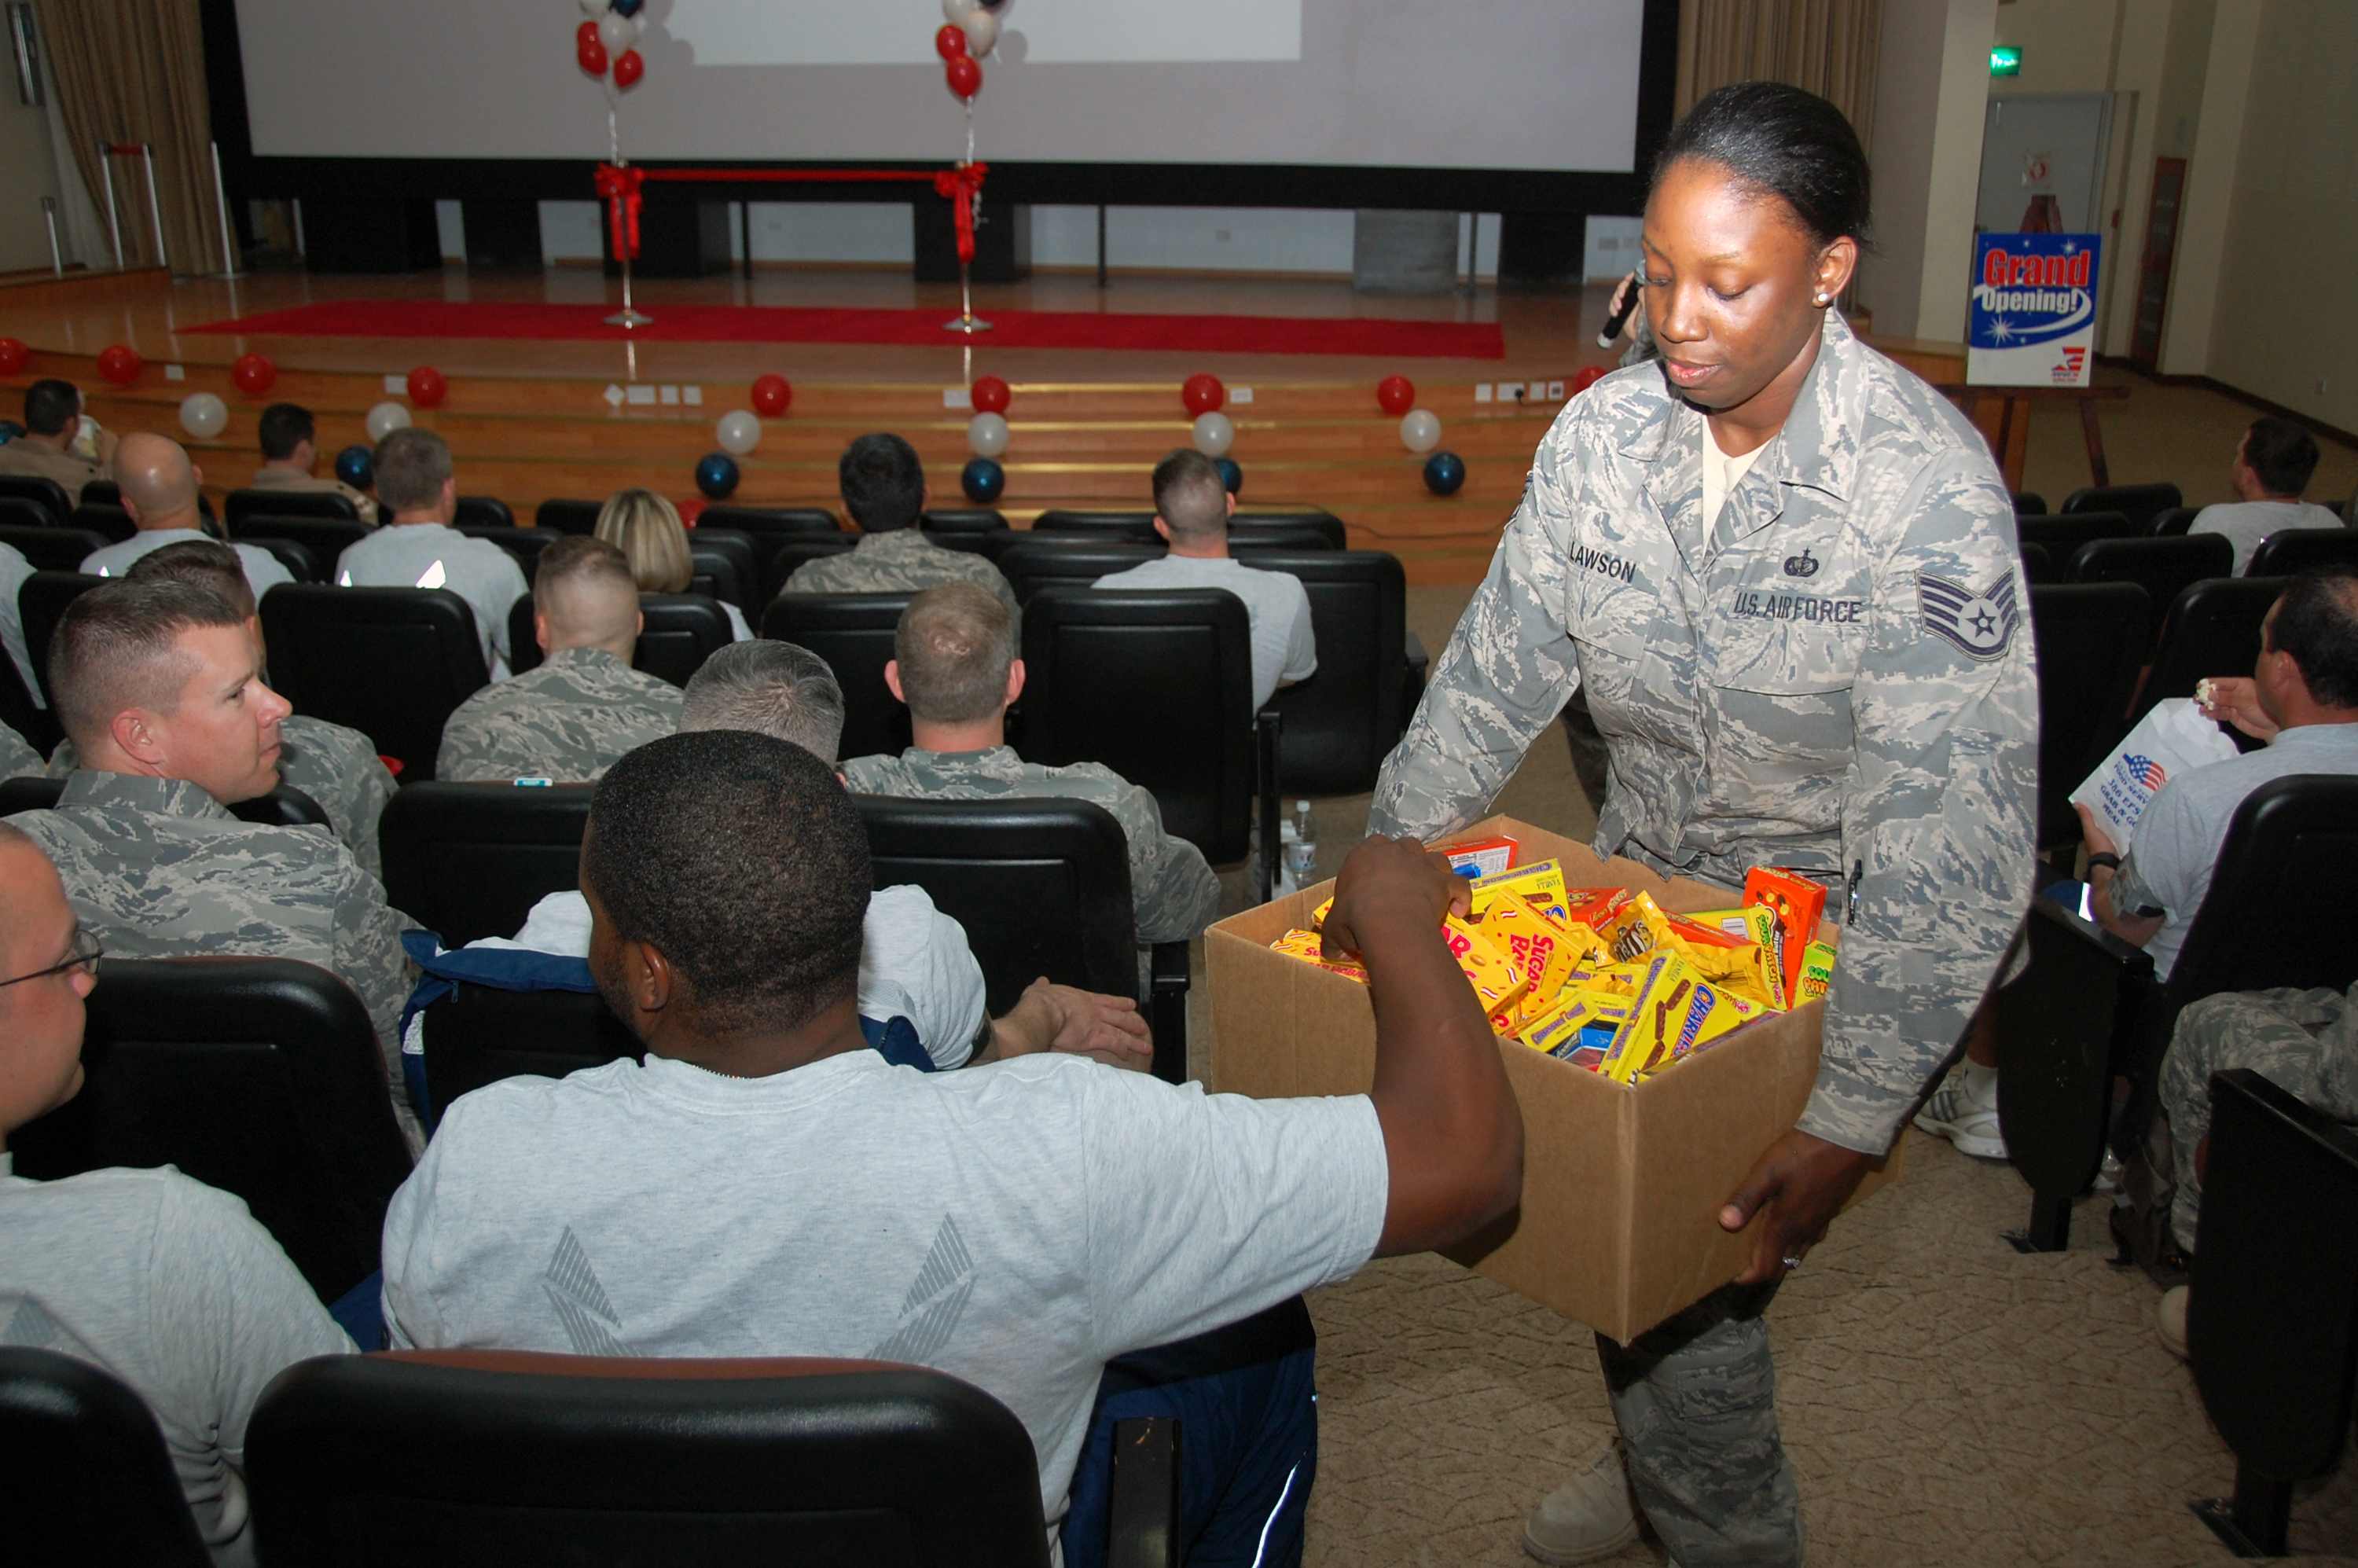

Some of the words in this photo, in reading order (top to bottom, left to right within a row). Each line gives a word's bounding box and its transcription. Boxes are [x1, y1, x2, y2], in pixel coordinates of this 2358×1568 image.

[1983, 248, 2091, 288] Grand
[1982, 288, 2077, 314] Opening!
[1570, 542, 1636, 582] LAWSON
[1734, 592, 1759, 615] U.S.
[1765, 596, 1791, 620] AIR
[1792, 598, 1861, 622] FORCE
[2101, 785, 2118, 809] GRAB
[2127, 785, 2148, 804] SERV
[2103, 803, 2121, 826] MEAL
[1756, 914, 1770, 946] SOUR
[1763, 944, 1779, 983] PATCH
[1528, 932, 1556, 993] SUGAR
[1808, 966, 1831, 983] SOU
[1803, 977, 1828, 995] PAT
